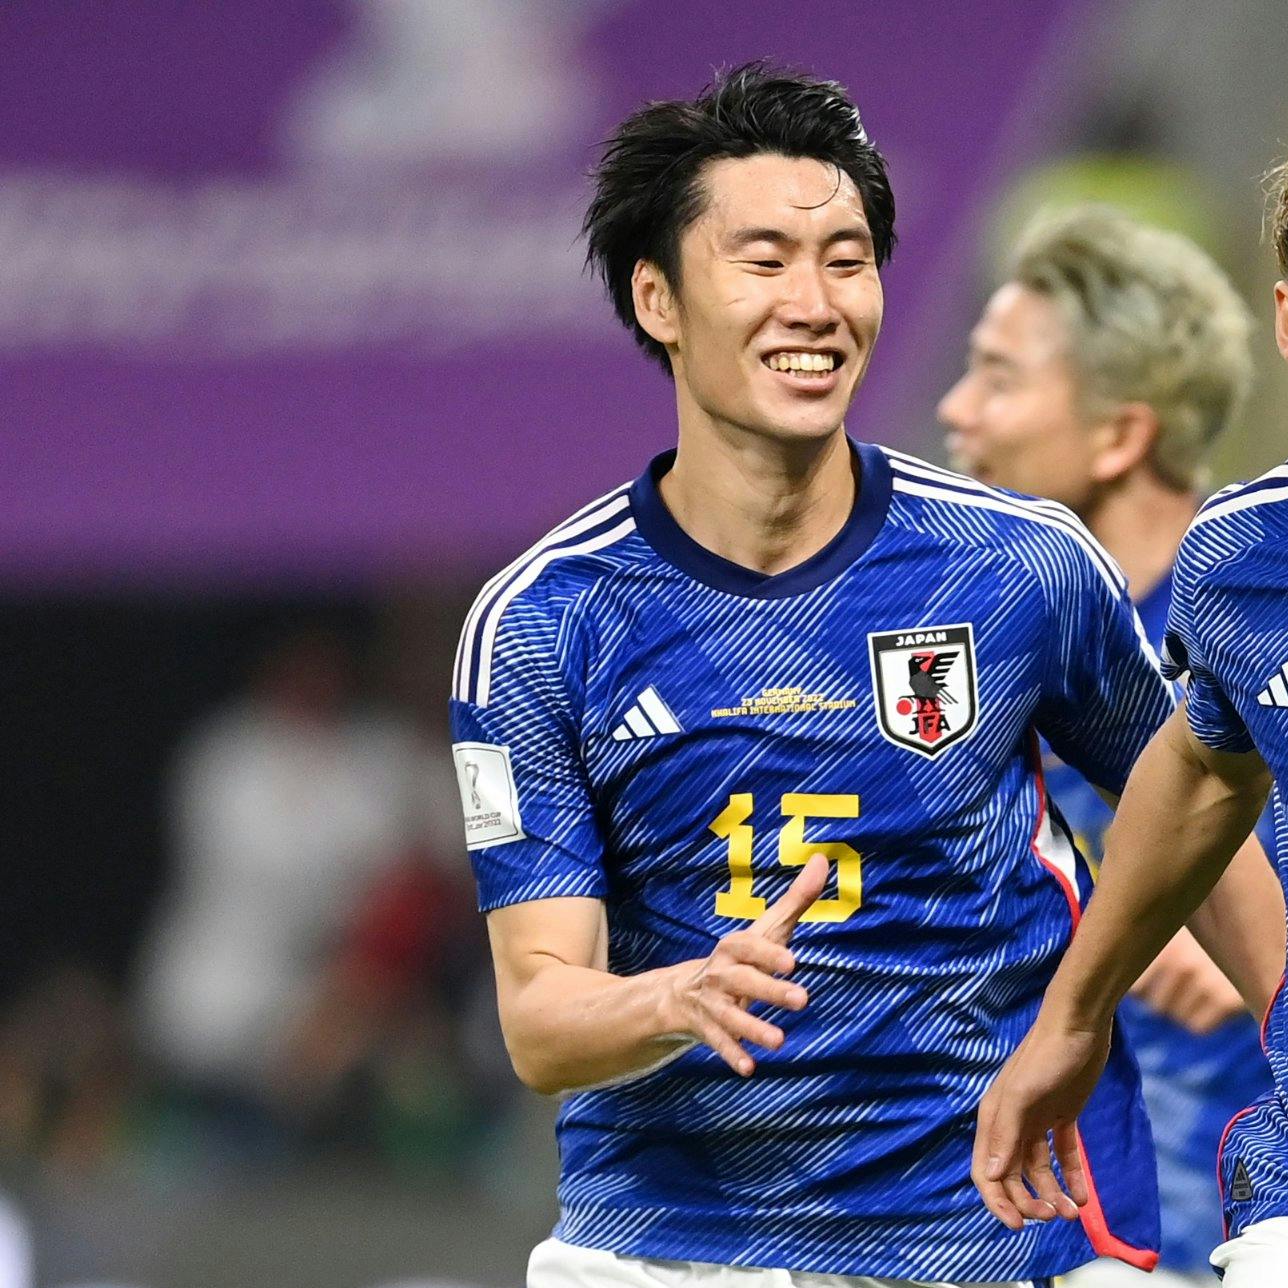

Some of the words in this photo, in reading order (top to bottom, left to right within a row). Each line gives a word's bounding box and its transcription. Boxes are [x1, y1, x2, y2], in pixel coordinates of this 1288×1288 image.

[895, 632, 948, 647] JAPAN
[755, 695, 800, 706] NOVEMBER
[802, 693, 824, 703] 2022
[711, 706, 748, 718] KHALIFA
[749, 703, 817, 716] INTERNATIONAL
[818, 700, 856, 711] STADIUM
[909, 714, 951, 735] JFA
[707, 793, 862, 923] 15
